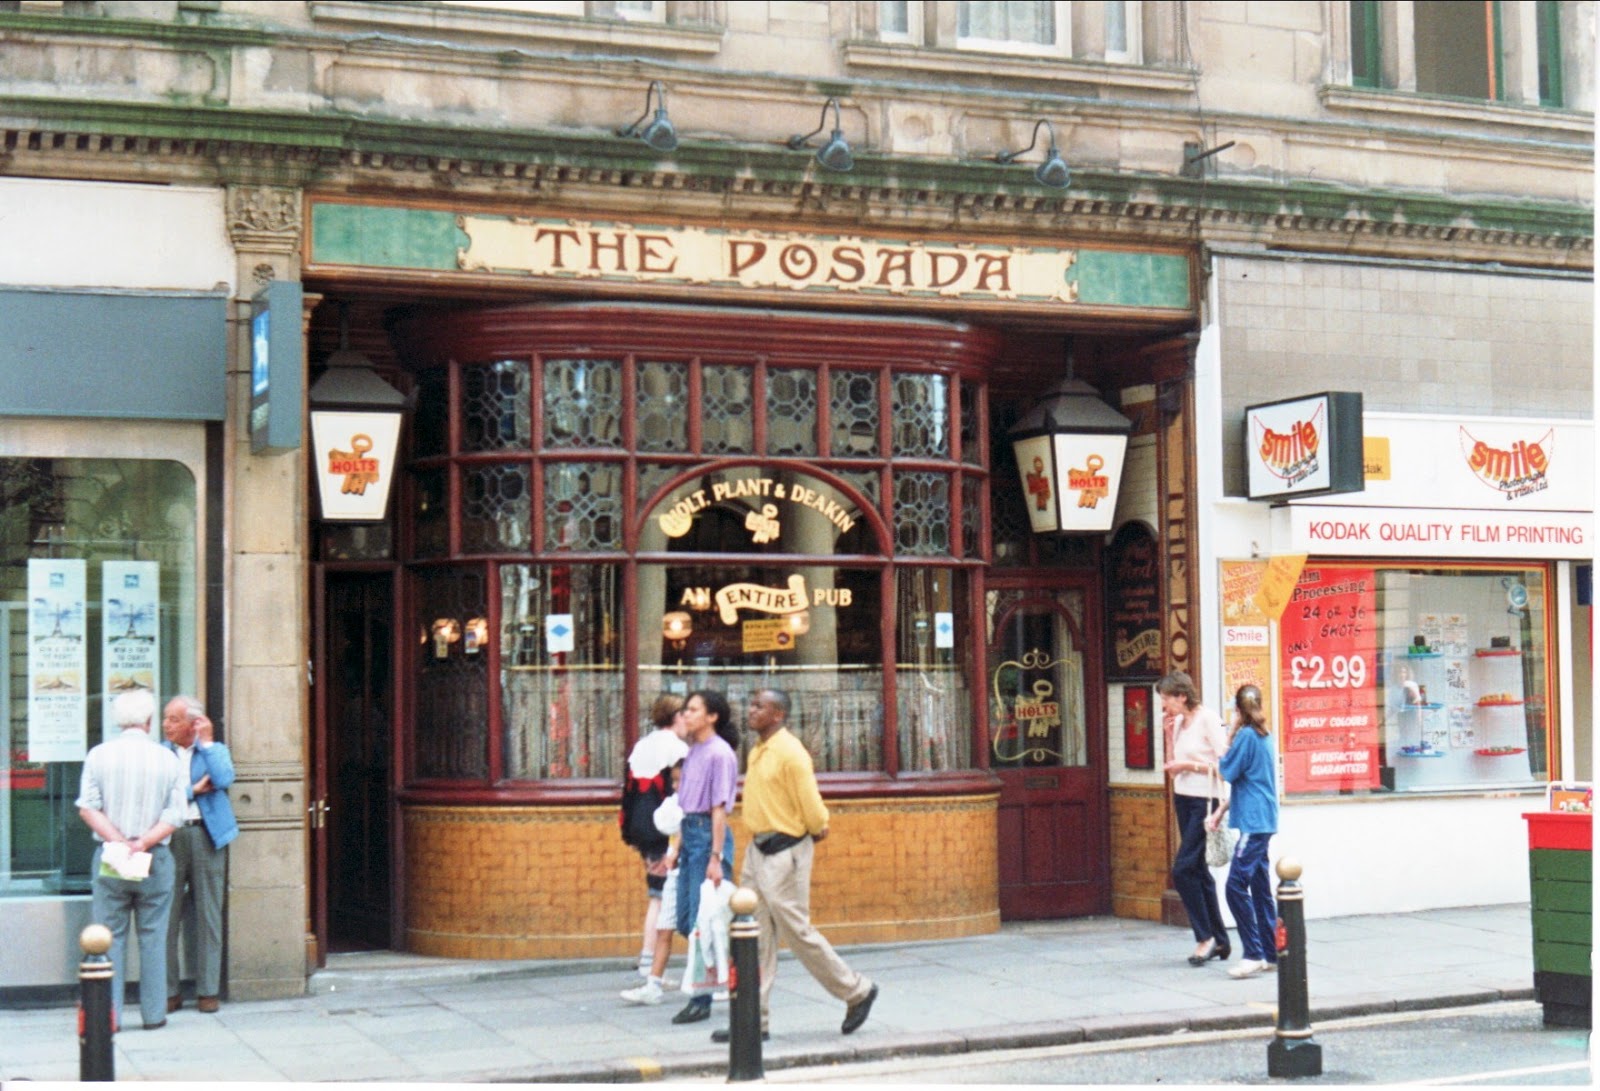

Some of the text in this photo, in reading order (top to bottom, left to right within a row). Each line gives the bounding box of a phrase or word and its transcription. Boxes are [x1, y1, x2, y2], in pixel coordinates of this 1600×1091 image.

[534, 228, 1012, 291] THE POSADA
[332, 459, 376, 472] HOLTS
[1362, 465, 1382, 475] dak
[1070, 477, 1107, 488] HOLTS
[712, 478, 773, 502] PLANT
[774, 483, 787, 499] &
[790, 484, 855, 534] DEAKIN
[1309, 521, 1584, 544] KODAK QUALITY FILM PRINTING
[1299, 569, 1320, 583] ilm
[1292, 580, 1366, 601] Processing
[681, 587, 853, 609] AN ENTIRE PUB
[1302, 606, 1320, 619] 24
[1349, 606, 1366, 619] 36
[1227, 628, 1263, 642] Smile
[1321, 623, 1362, 638] SHOTS
[1291, 655, 1366, 689] £2.99
[1017, 704, 1058, 718] HOLTS
[1329, 715, 1369, 728] COLOURS
